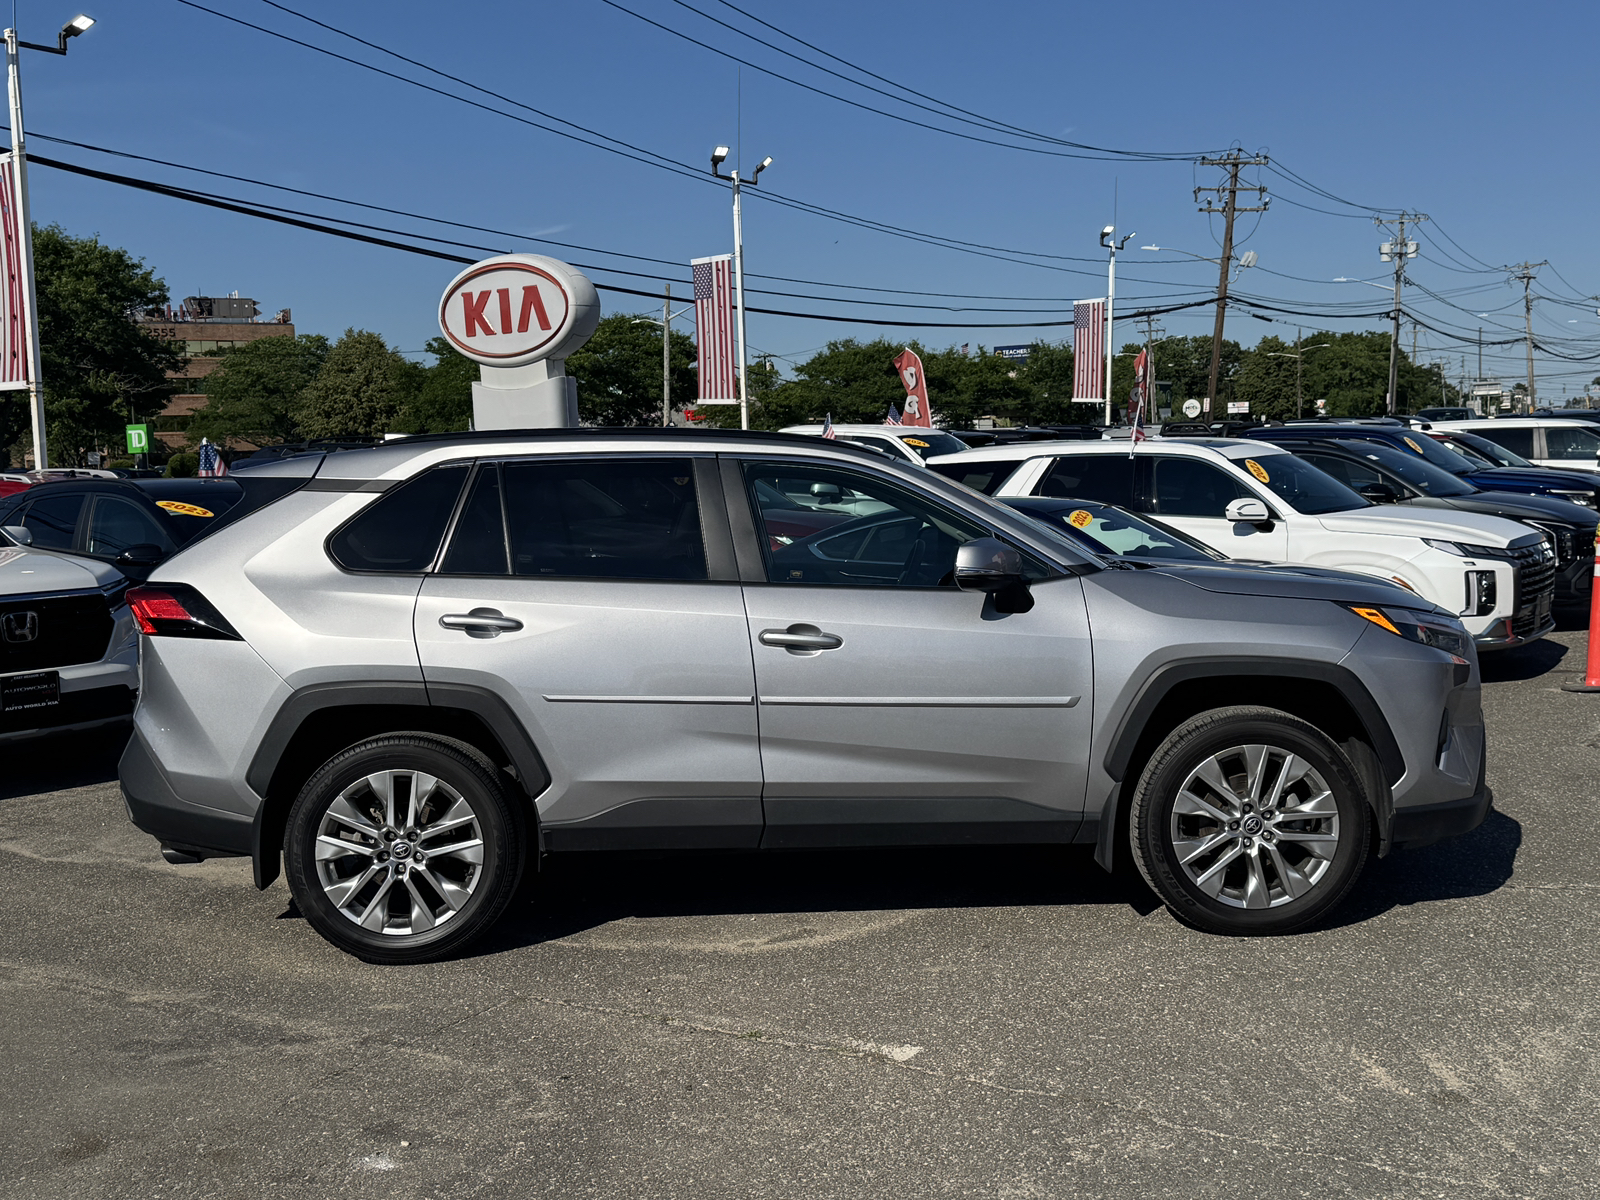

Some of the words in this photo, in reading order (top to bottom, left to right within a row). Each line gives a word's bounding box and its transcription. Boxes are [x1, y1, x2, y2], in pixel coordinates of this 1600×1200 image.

[461, 285, 552, 337] KIA
[147, 328, 175, 338] 2555
[128, 430, 146, 448] TD
[161, 501, 209, 516] 2023
[1073, 510, 1090, 526] 2023
[1161, 867, 1197, 909] OPEN
